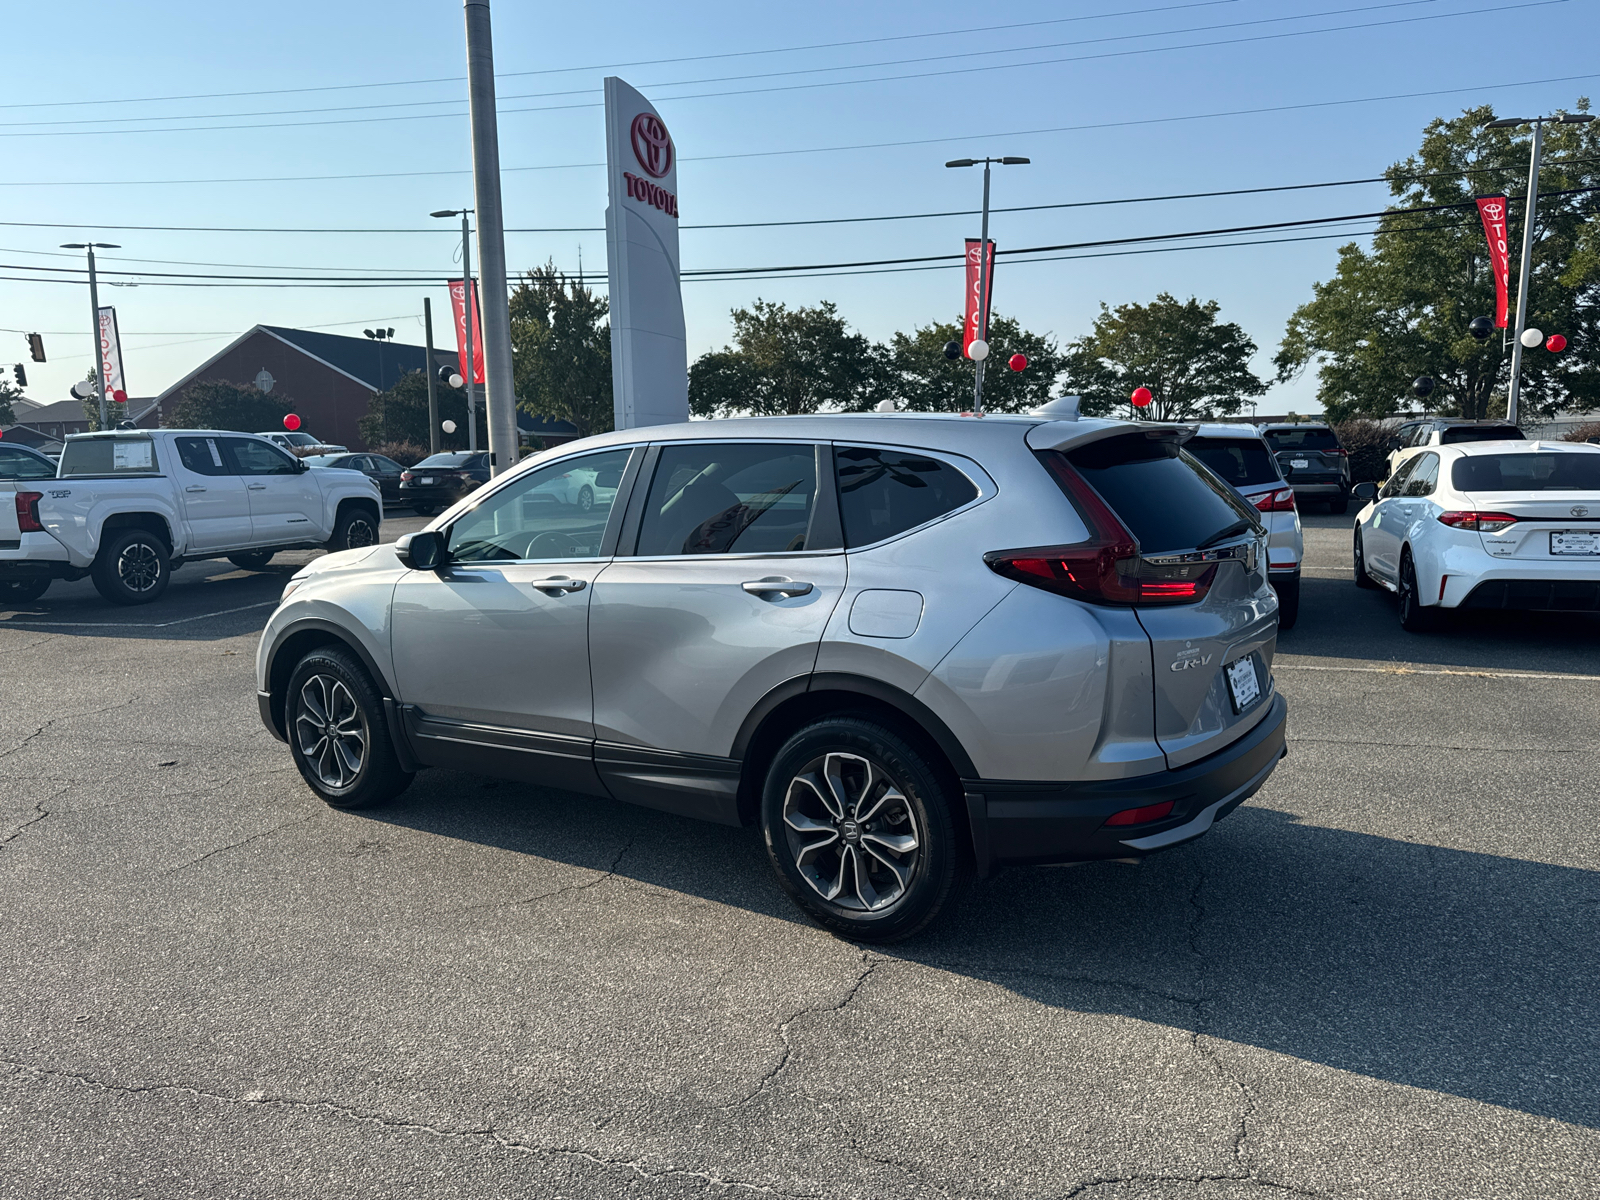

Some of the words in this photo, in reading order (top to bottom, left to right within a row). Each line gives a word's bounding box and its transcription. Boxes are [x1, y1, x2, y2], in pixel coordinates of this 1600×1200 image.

[623, 171, 679, 219] TOYOTA
[100, 328, 115, 394] TOYOTA
[1170, 653, 1213, 671] CR-V
